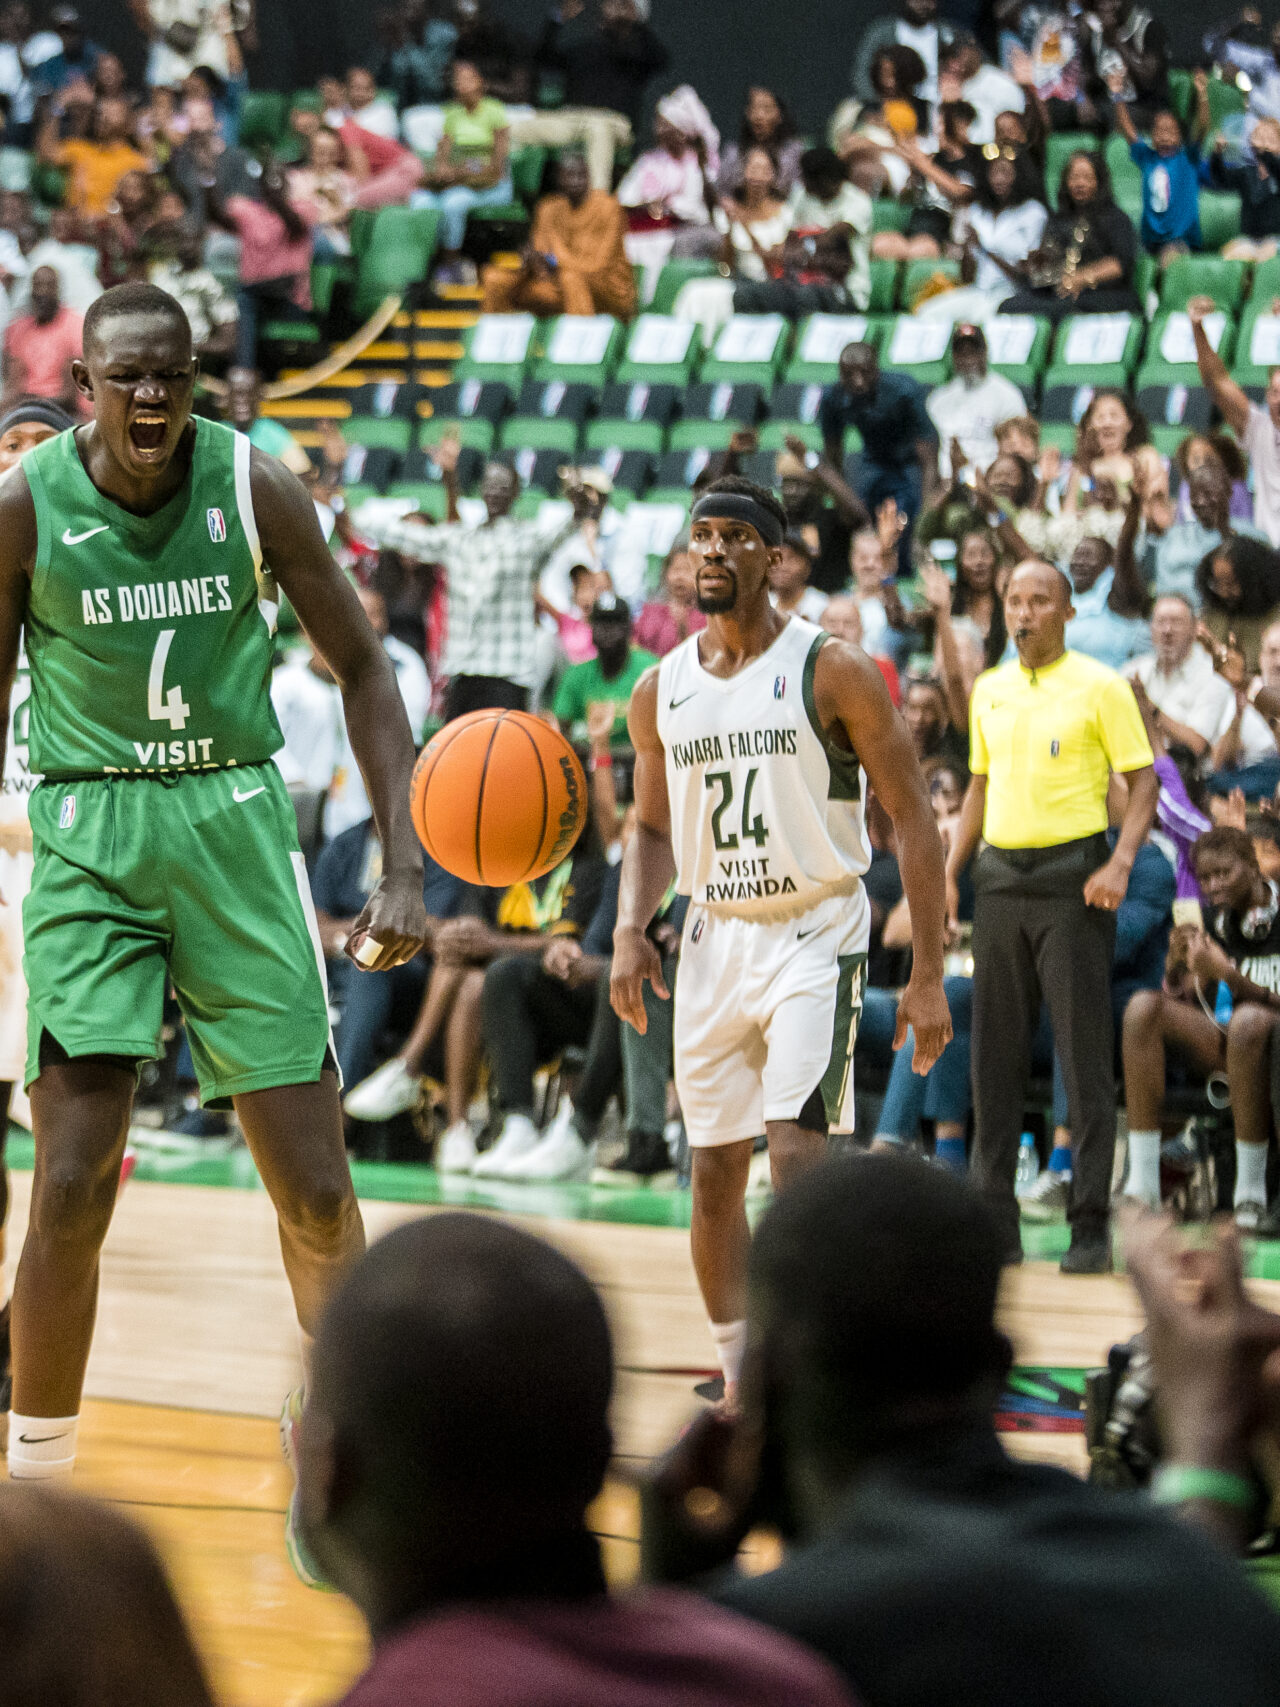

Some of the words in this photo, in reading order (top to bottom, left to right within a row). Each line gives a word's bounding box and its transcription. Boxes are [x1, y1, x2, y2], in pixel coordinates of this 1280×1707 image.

[81, 588, 113, 625] AS
[117, 575, 233, 622] DOUANES
[148, 629, 190, 730] 4
[133, 738, 213, 766] VISIT
[672, 736, 724, 770] KWARA
[728, 729, 797, 758] FALCONS
[704, 768, 769, 851] 24
[720, 859, 769, 878] VISIT
[706, 877, 798, 902] RWANDA
